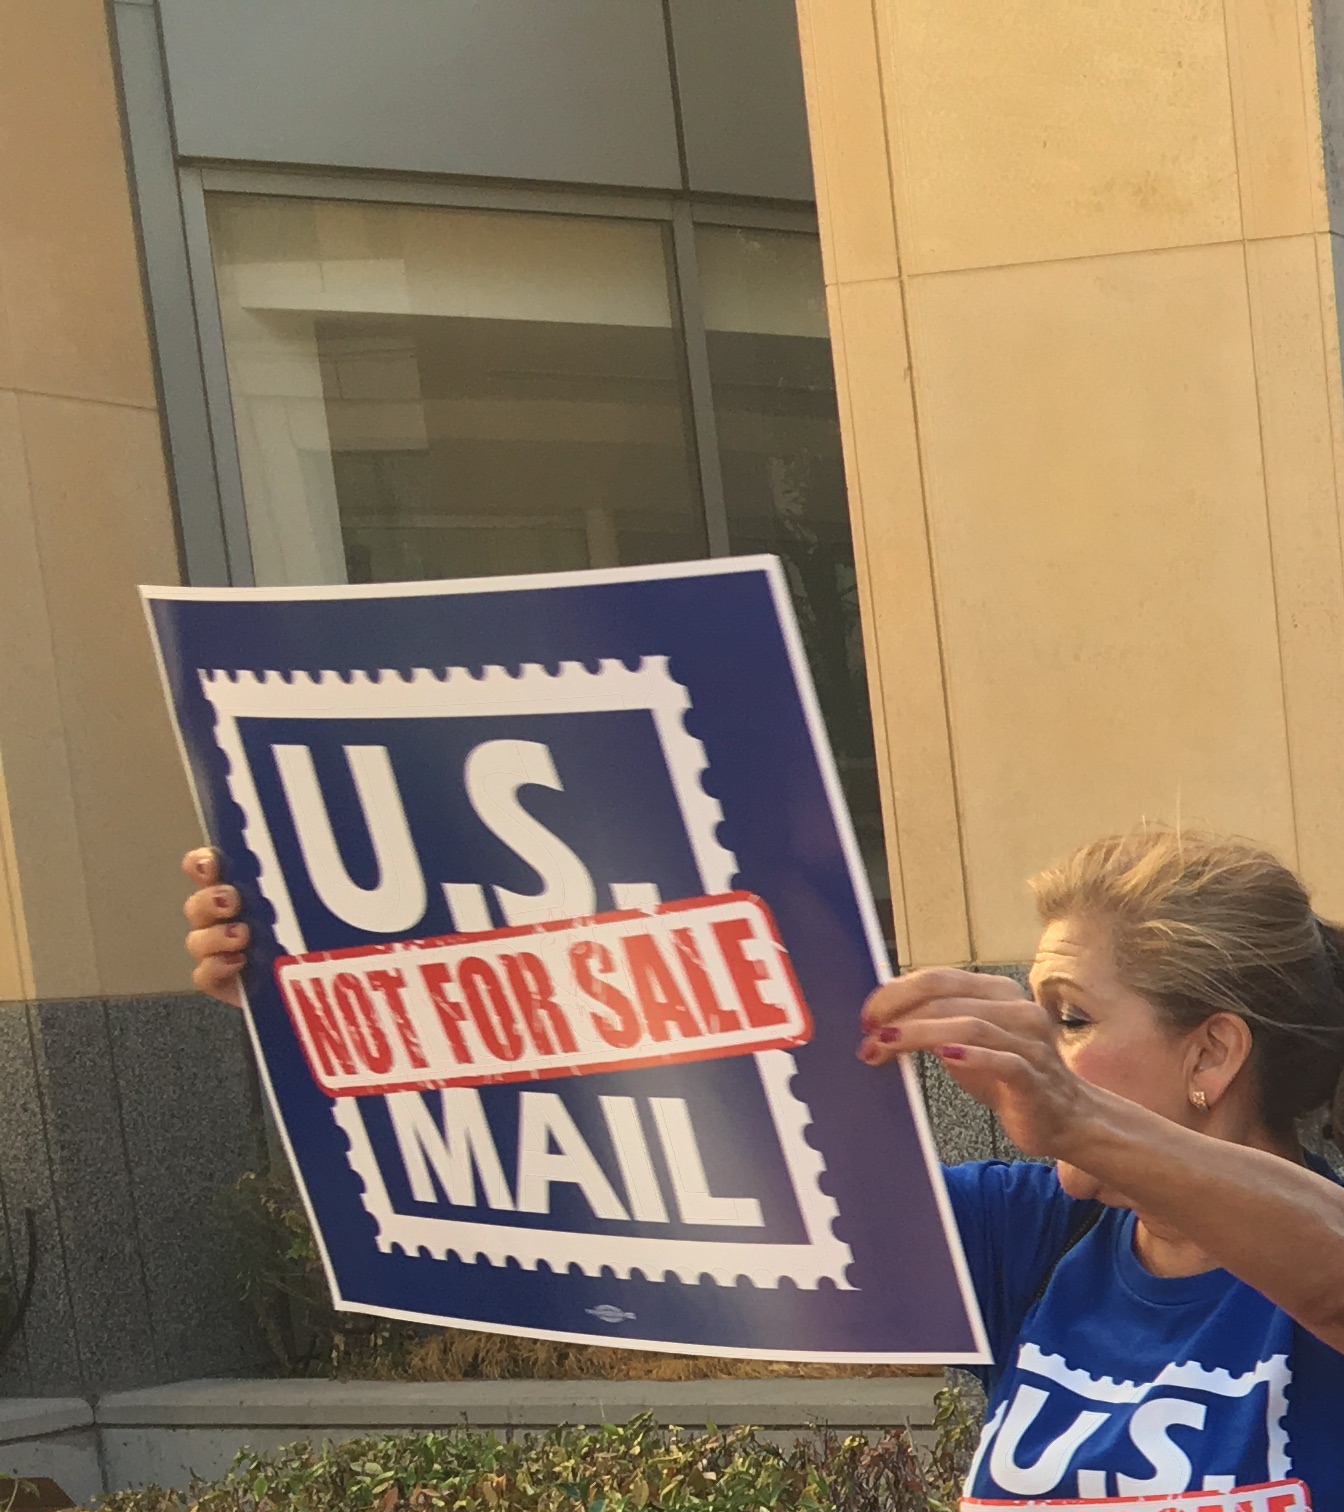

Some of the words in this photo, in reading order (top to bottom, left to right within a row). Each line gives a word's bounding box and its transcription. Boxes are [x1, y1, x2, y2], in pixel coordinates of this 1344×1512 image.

[272, 739, 659, 934] U.S.
[288, 964, 427, 1078] NOT
[417, 953, 579, 1066] FOR
[568, 917, 788, 1048] SALE
[386, 1089, 766, 1229] MAIL
[989, 1384, 1236, 1498] U.S.
